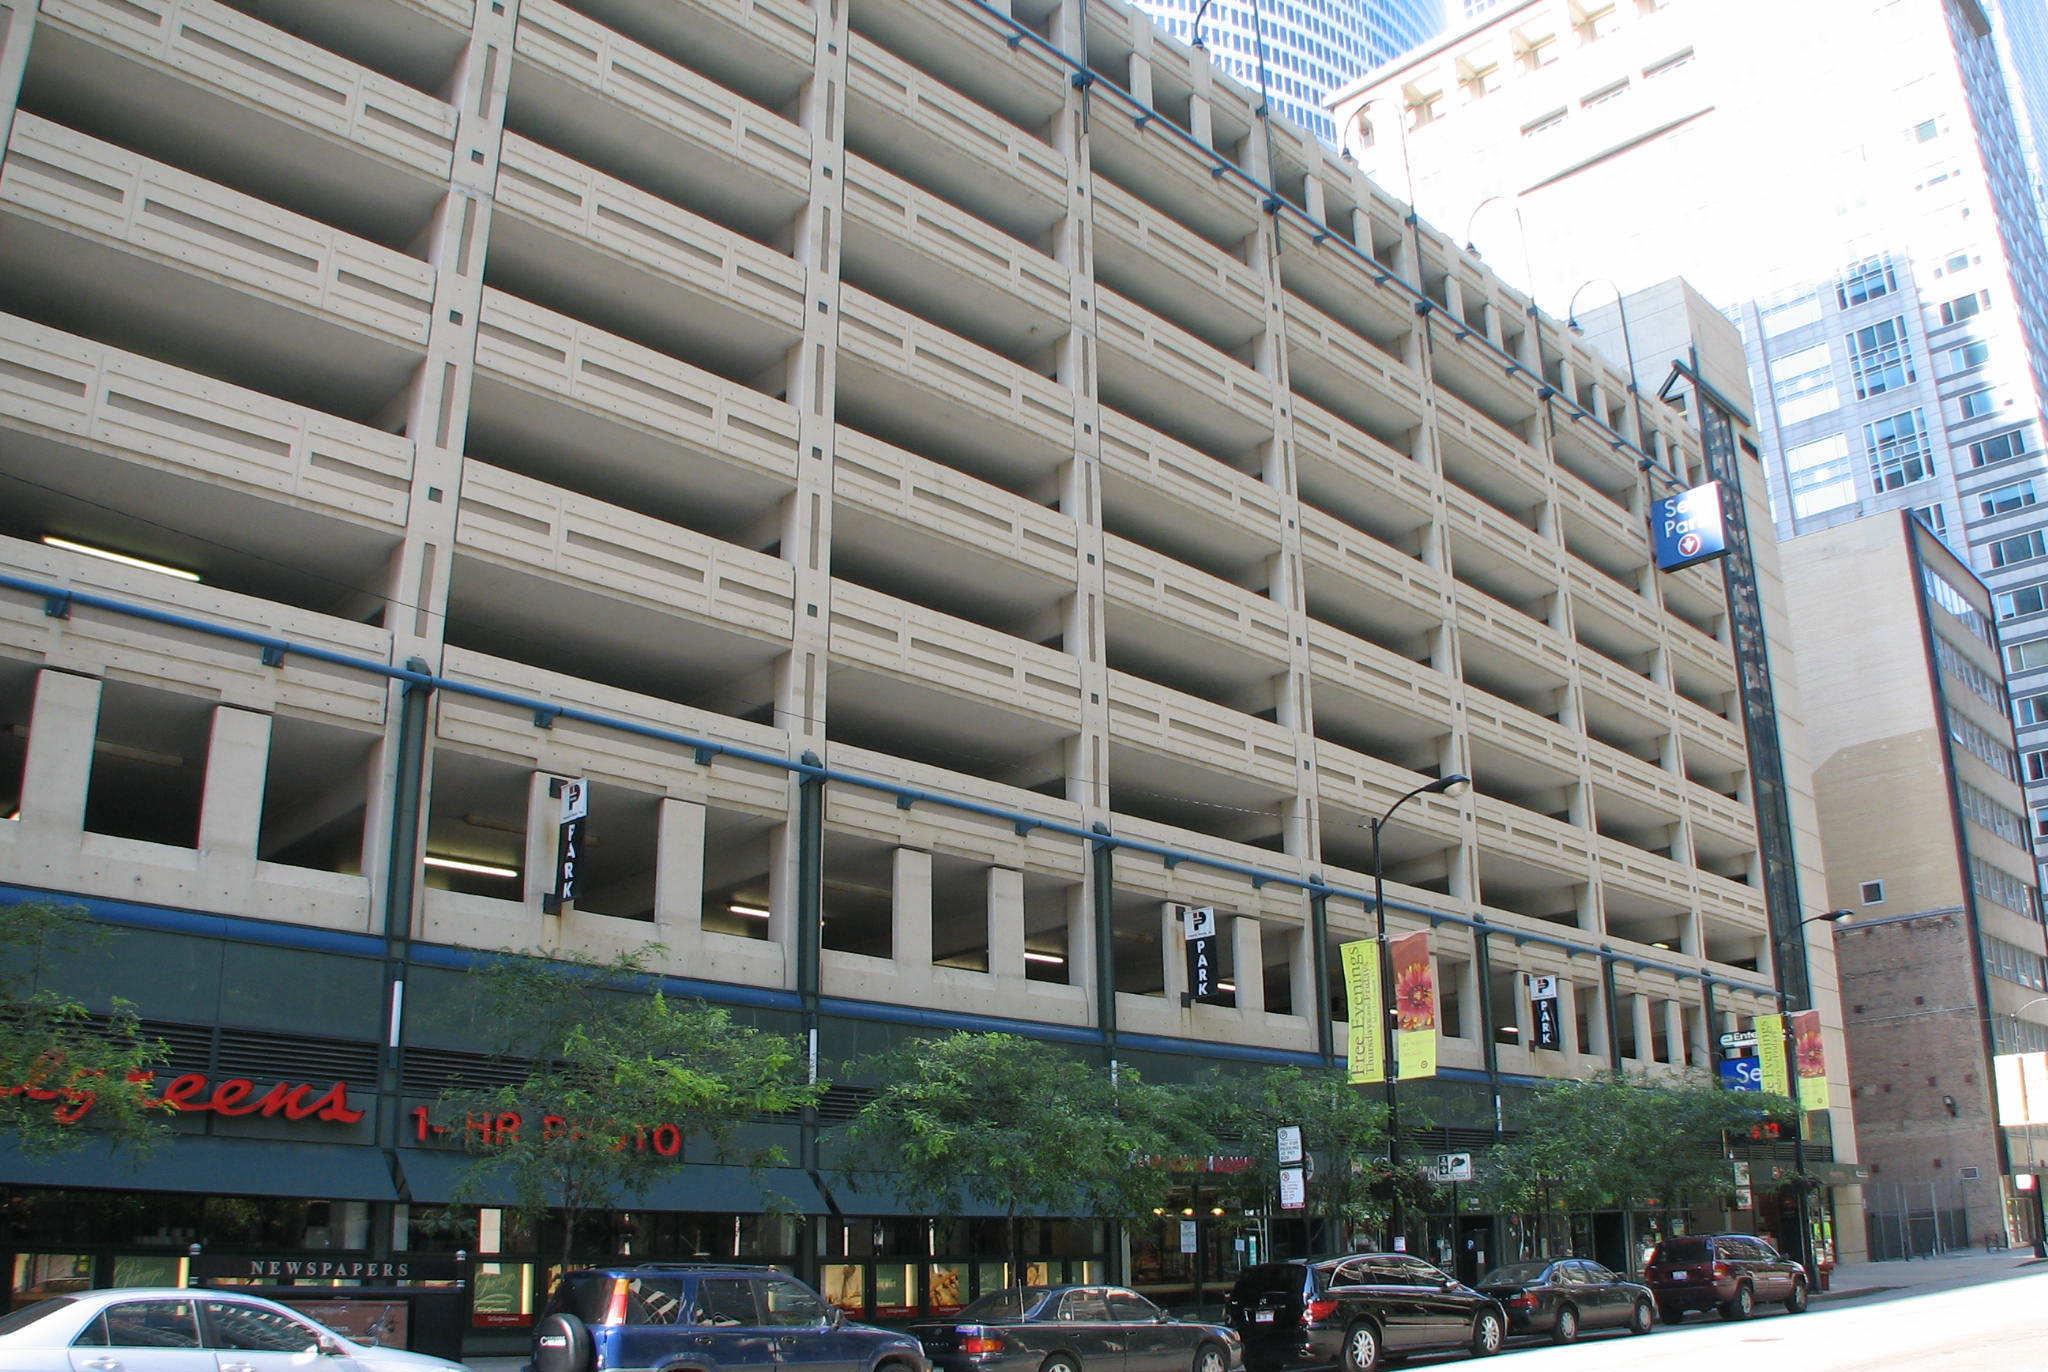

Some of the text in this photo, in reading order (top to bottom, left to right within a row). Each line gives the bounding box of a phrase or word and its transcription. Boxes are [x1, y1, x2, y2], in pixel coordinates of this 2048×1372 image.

[562, 824, 576, 899] PARK
[1196, 940, 1208, 996] PARK
[1348, 945, 1365, 1076] Free Evenings
[1540, 1001, 1551, 1043] PARK
[250, 1260, 409, 1277] NEWSPAPERS
